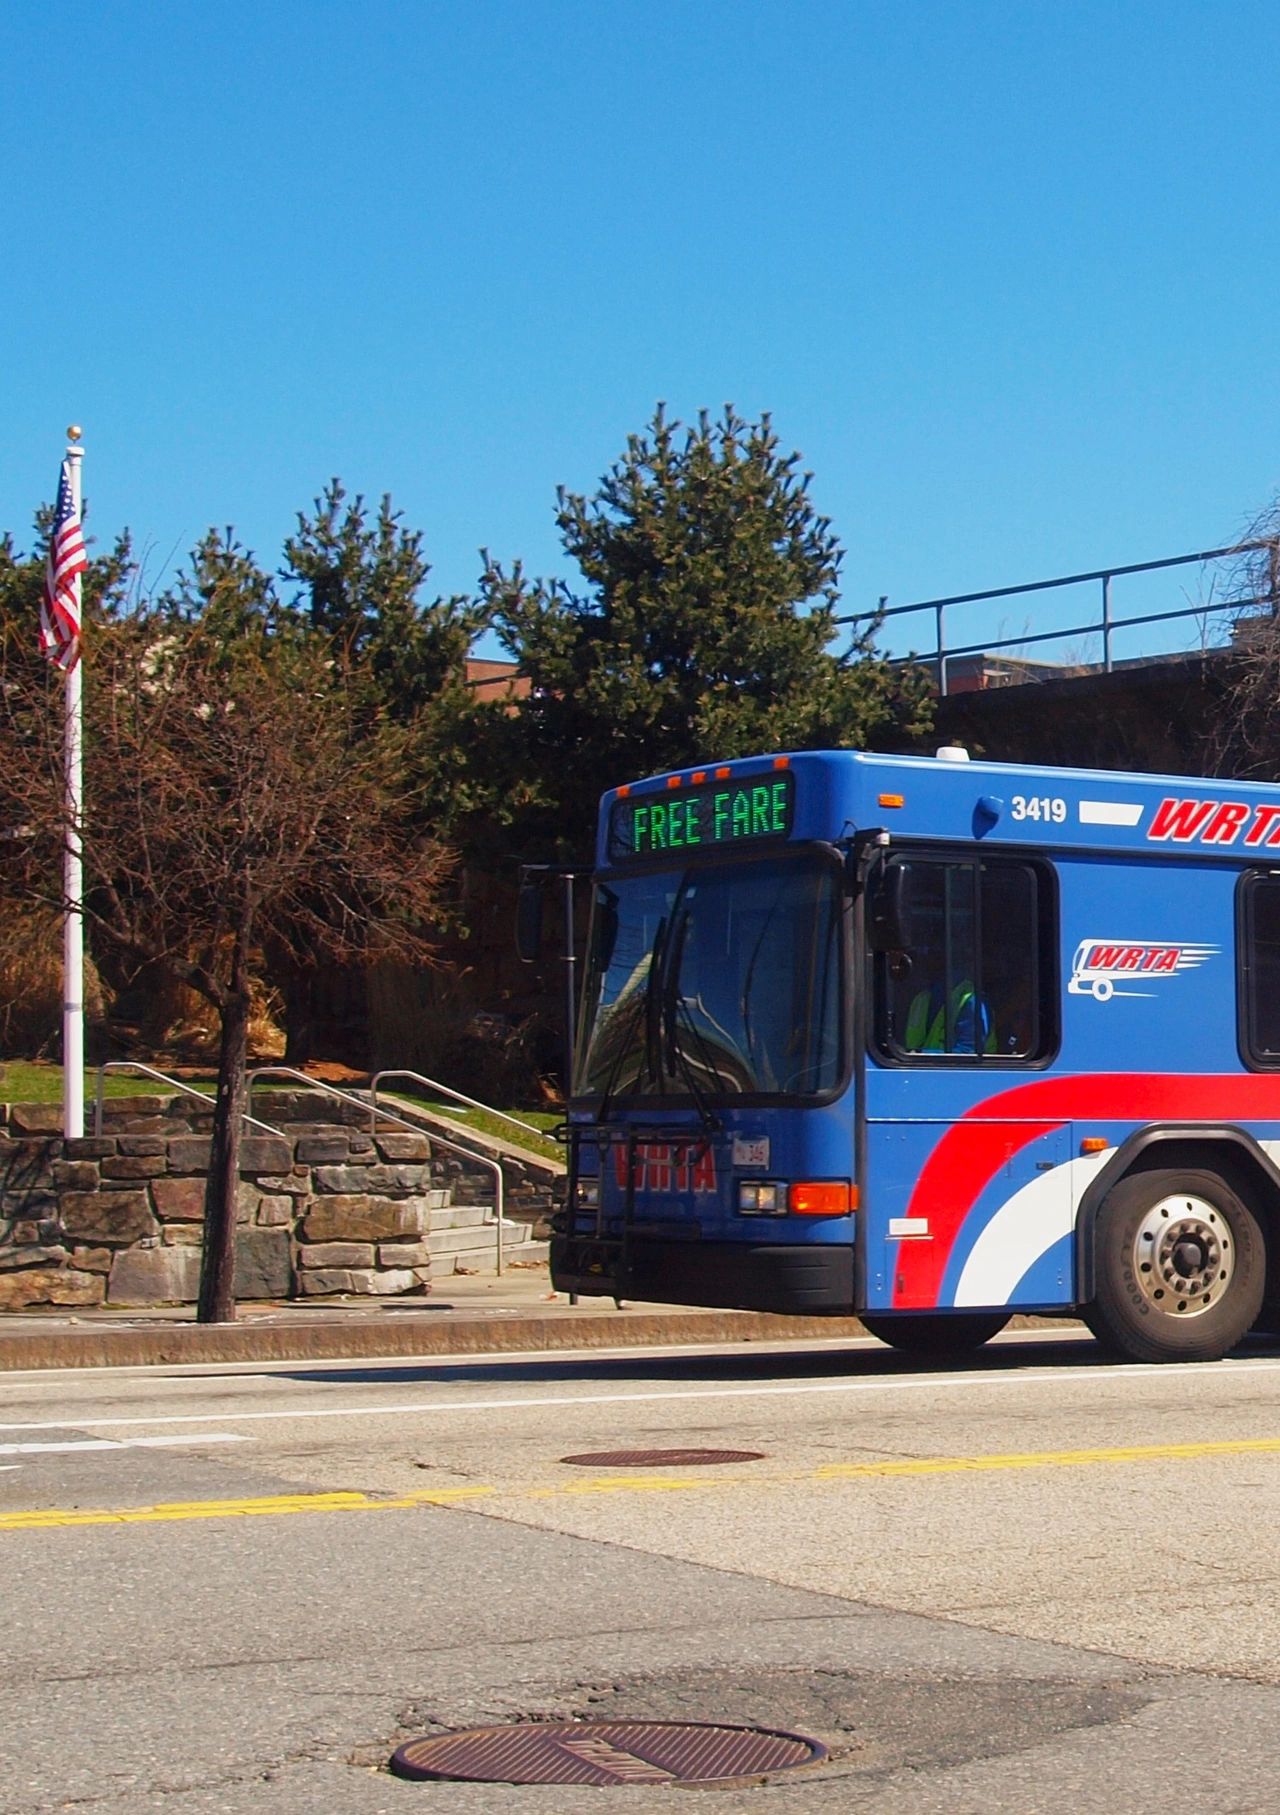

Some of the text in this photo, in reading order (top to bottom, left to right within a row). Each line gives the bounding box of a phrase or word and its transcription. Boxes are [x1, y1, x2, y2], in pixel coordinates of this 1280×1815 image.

[634, 783, 787, 852] FREE FARE
[1011, 796, 1067, 823] 3419
[1088, 945, 1181, 972] WRTA
